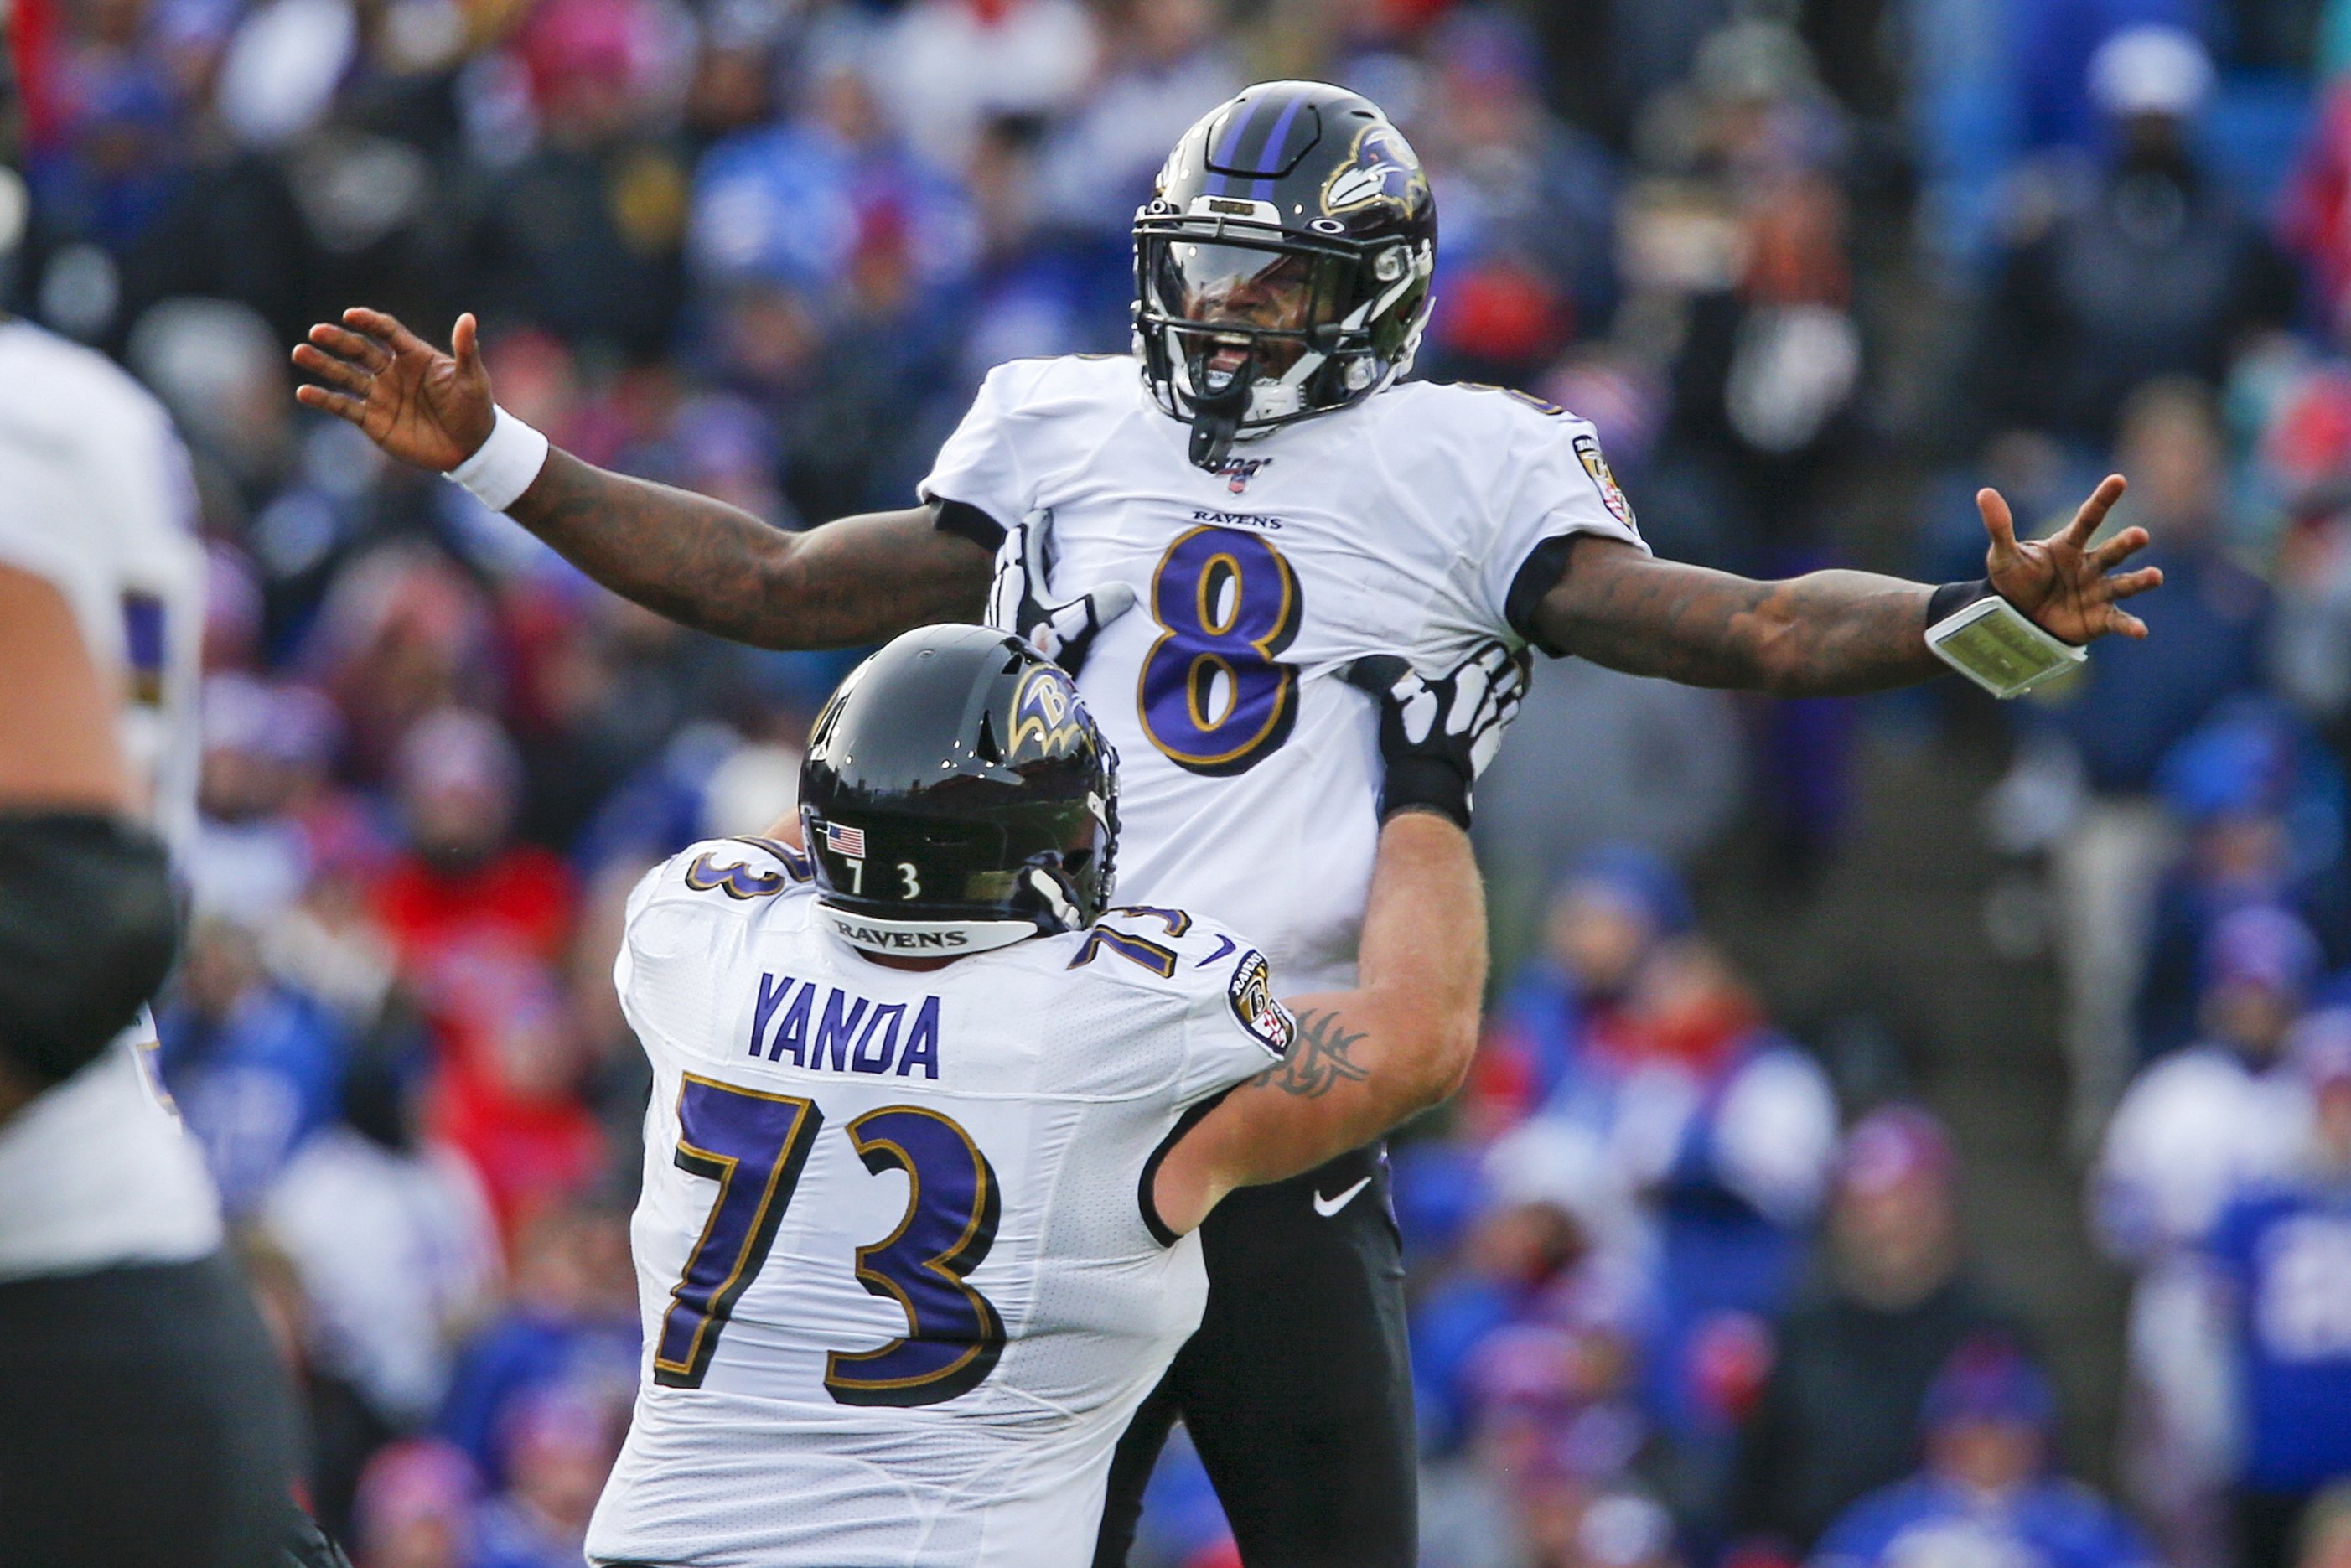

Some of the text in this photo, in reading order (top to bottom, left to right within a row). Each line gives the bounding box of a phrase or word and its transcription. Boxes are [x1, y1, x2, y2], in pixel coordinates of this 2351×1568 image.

[1191, 510, 1282, 530] RAVENS
[1137, 524, 1304, 779] 8
[832, 919, 969, 949] RAVENS
[748, 972, 940, 1080] YANDA
[653, 1070, 1007, 1408] 73
